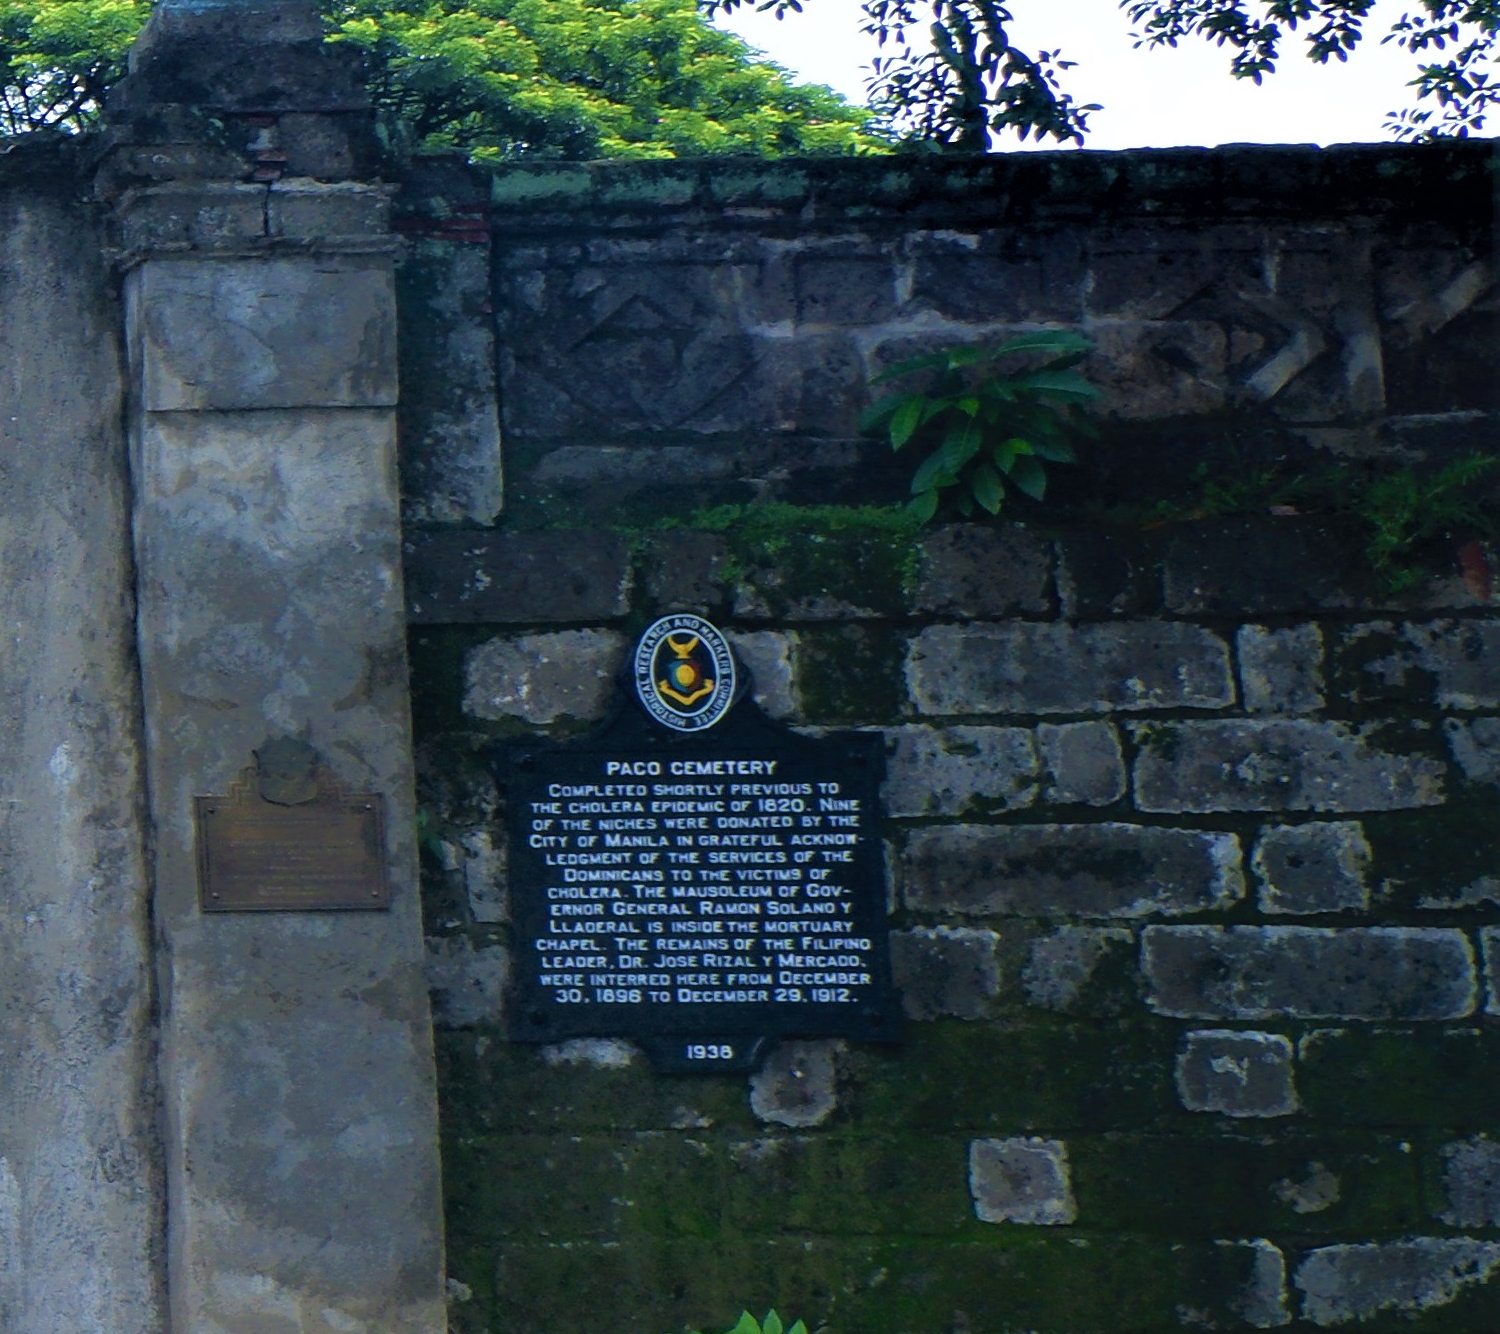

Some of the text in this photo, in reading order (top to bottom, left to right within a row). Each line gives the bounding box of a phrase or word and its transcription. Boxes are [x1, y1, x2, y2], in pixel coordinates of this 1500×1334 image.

[606, 761, 777, 775] PACO CEMETERY
[549, 783, 839, 798] COMPLETED SHORTLY PREVIOUS TO
[530, 803, 562, 814] THE
[569, 802, 644, 813] CHOLERA
[652, 801, 724, 812] EPIDEMIC
[731, 801, 751, 812] OF
[819, 799, 860, 811] NINE
[532, 816, 860, 830] OF THE NICHES WERE DONATED BY THE
[529, 835, 569, 848] CITY
[578, 837, 597, 848] OF
[605, 834, 668, 847] MANILA
[677, 836, 692, 846] IN
[699, 834, 783, 846] GRATEFUL
[546, 851, 854, 865] LEDGMENT OF THE SERVICES OF THE
[564, 869, 830, 882] DOMINICANS TO THE VICTIMS OF
[634, 885, 666, 898] THE
[673, 886, 772, 897] MAUSOLEUM
[779, 886, 799, 896] OF
[551, 902, 853, 916] ERNOR GENERAL RAMON SOLANO Y
[550, 920, 853, 933] LLADERAL IS INSIDE THE MORTUARY
[614, 938, 649, 950] THE
[656, 939, 729, 950] REMAINS
[734, 939, 754, 950] OF
[763, 939, 795, 950] THE
[802, 937, 872, 950] FILIPINO
[654, 955, 698, 968] JOSE
[703, 954, 756, 967] RIZAL
[762, 956, 772, 967] Y
[539, 971, 872, 985] WERE INTERRED HERE FROM DECEMBER
[596, 988, 643, 1002] 1896
[650, 991, 670, 1002] TO
[677, 988, 768, 1002] DECEMBER
